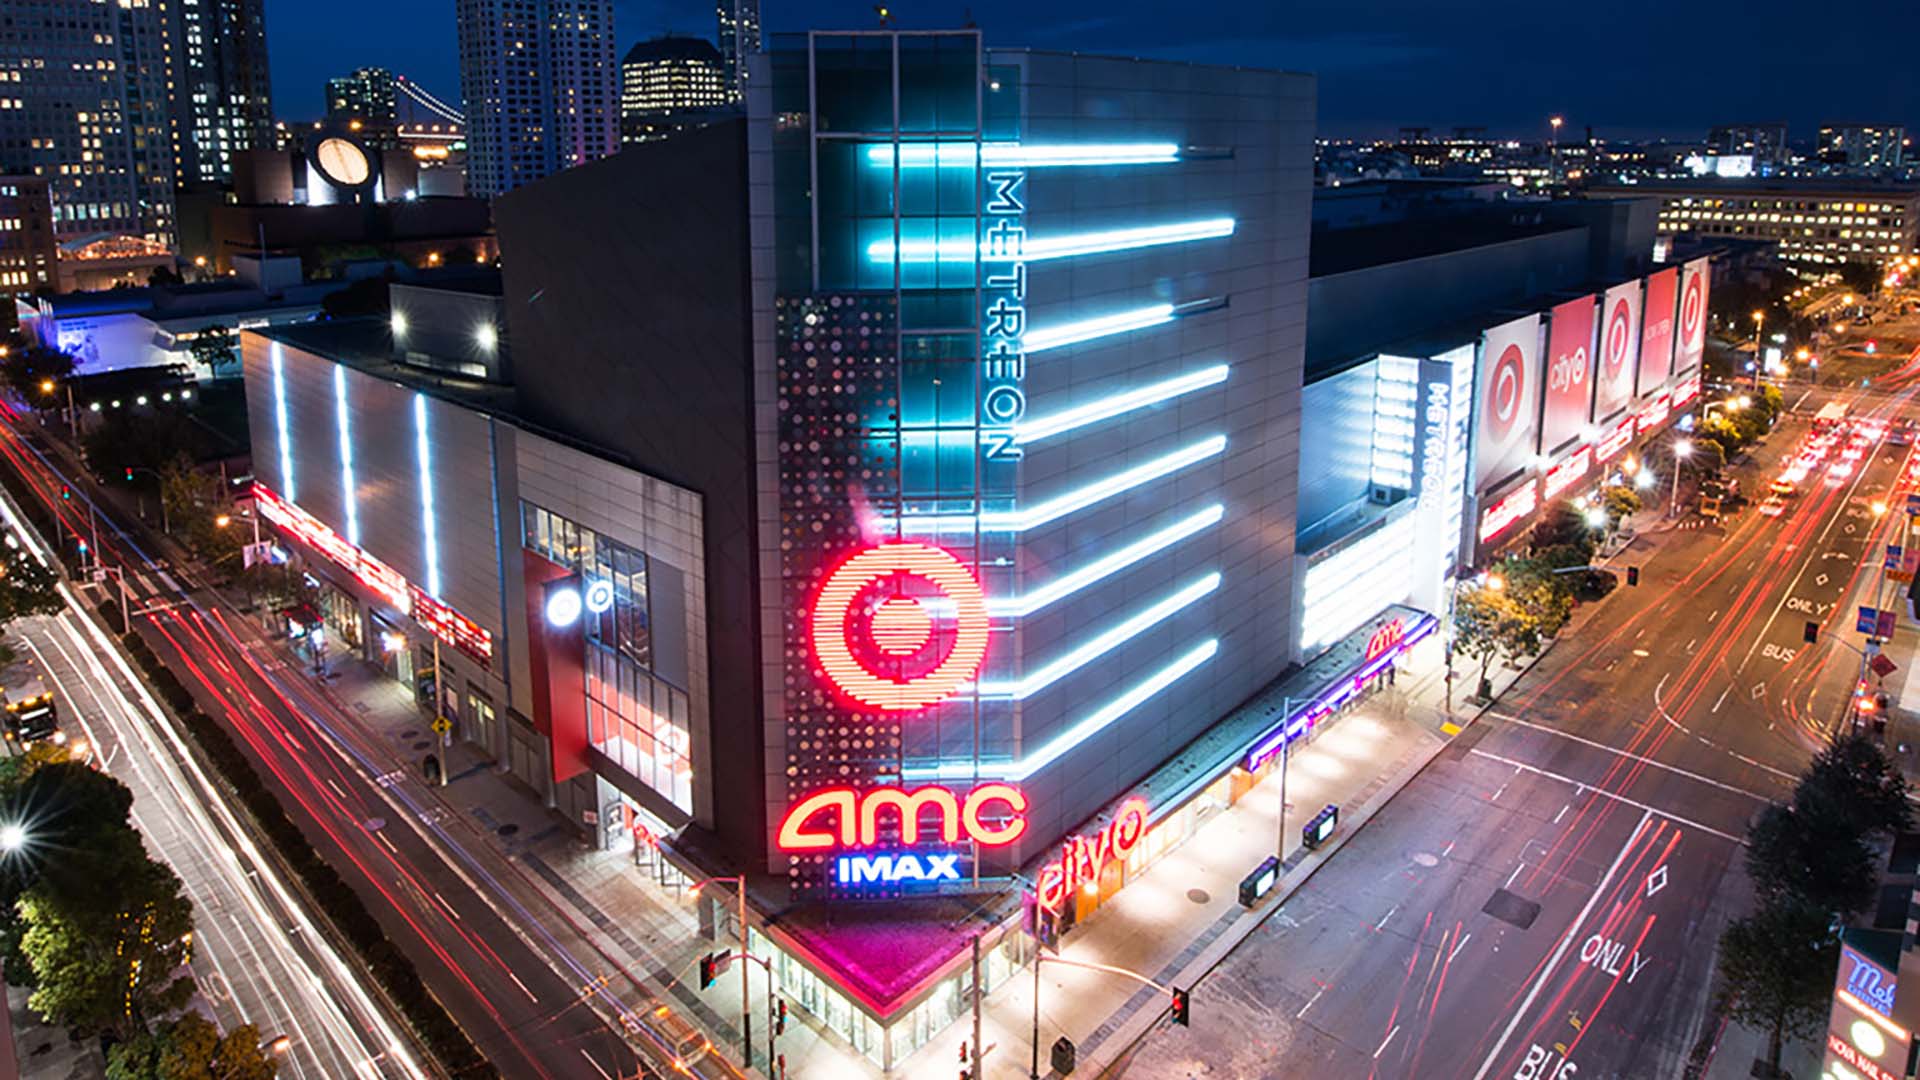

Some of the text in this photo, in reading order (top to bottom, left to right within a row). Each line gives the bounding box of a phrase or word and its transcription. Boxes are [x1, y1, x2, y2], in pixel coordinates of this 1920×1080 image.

[985, 171, 1026, 461] METREON
[1786, 597, 1828, 615] ONLY
[1762, 643, 1797, 663] BUS
[838, 854, 960, 883] IMAX
[1580, 934, 1651, 984] ONLY
